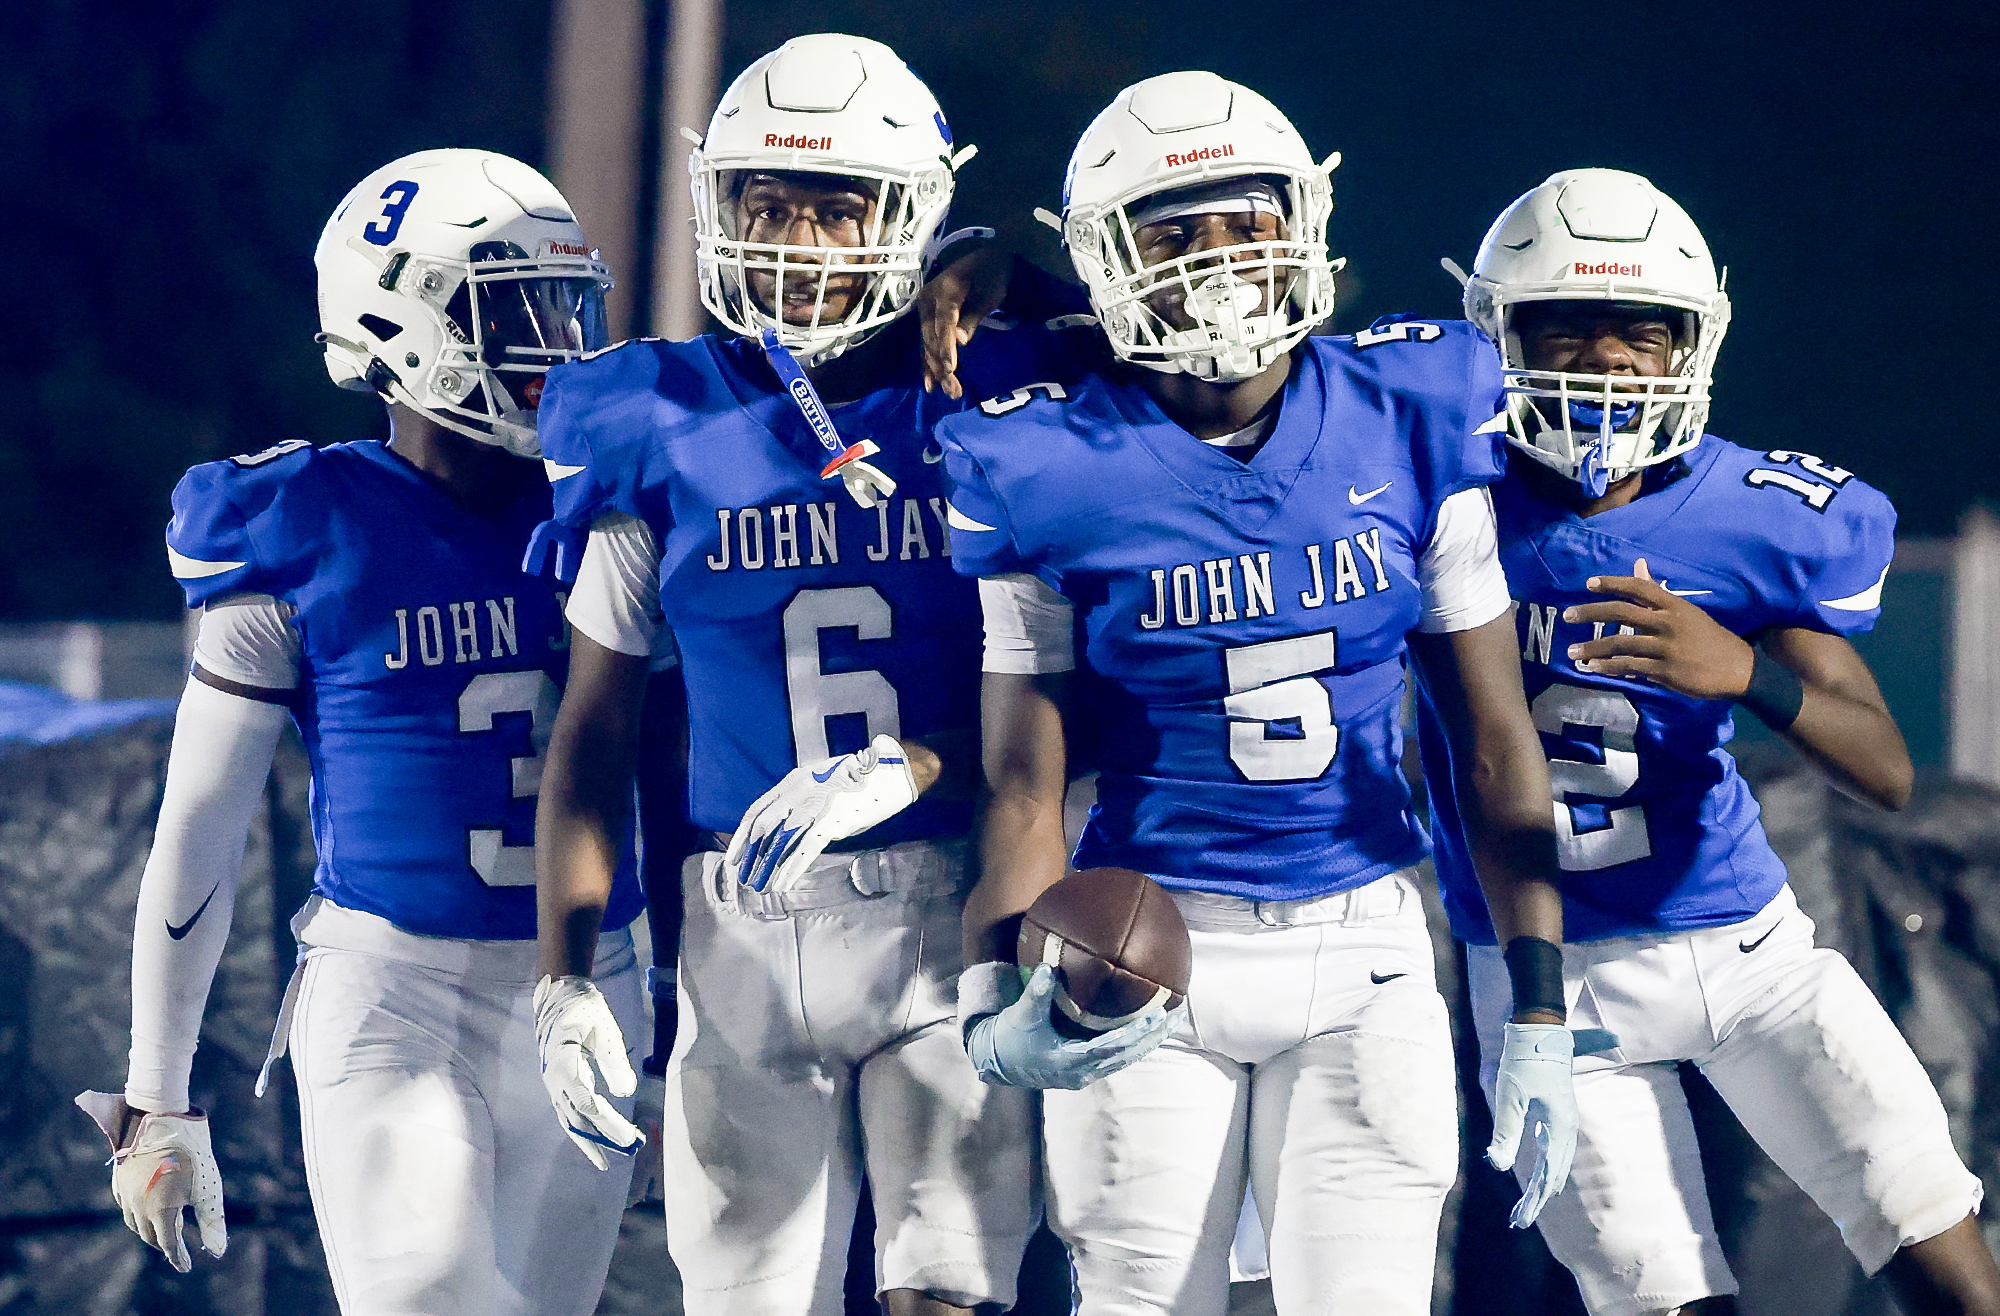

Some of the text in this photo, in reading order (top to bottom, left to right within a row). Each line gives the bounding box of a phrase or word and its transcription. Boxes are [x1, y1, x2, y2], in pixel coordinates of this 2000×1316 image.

[765, 133, 831, 151] Riddell
[1166, 144, 1235, 168] Riddell
[363, 180, 420, 246] 3
[1574, 260, 1643, 278] Riddell
[794, 383, 834, 445] BATTLE
[1746, 449, 1856, 511] 12
[707, 496, 952, 571] JOHN JAY
[1140, 528, 1391, 629] JOHN JAY
[384, 596, 519, 670] JOHN
[782, 585, 902, 770] 6
[1222, 630, 1339, 782] 5
[458, 669, 562, 888] 3
